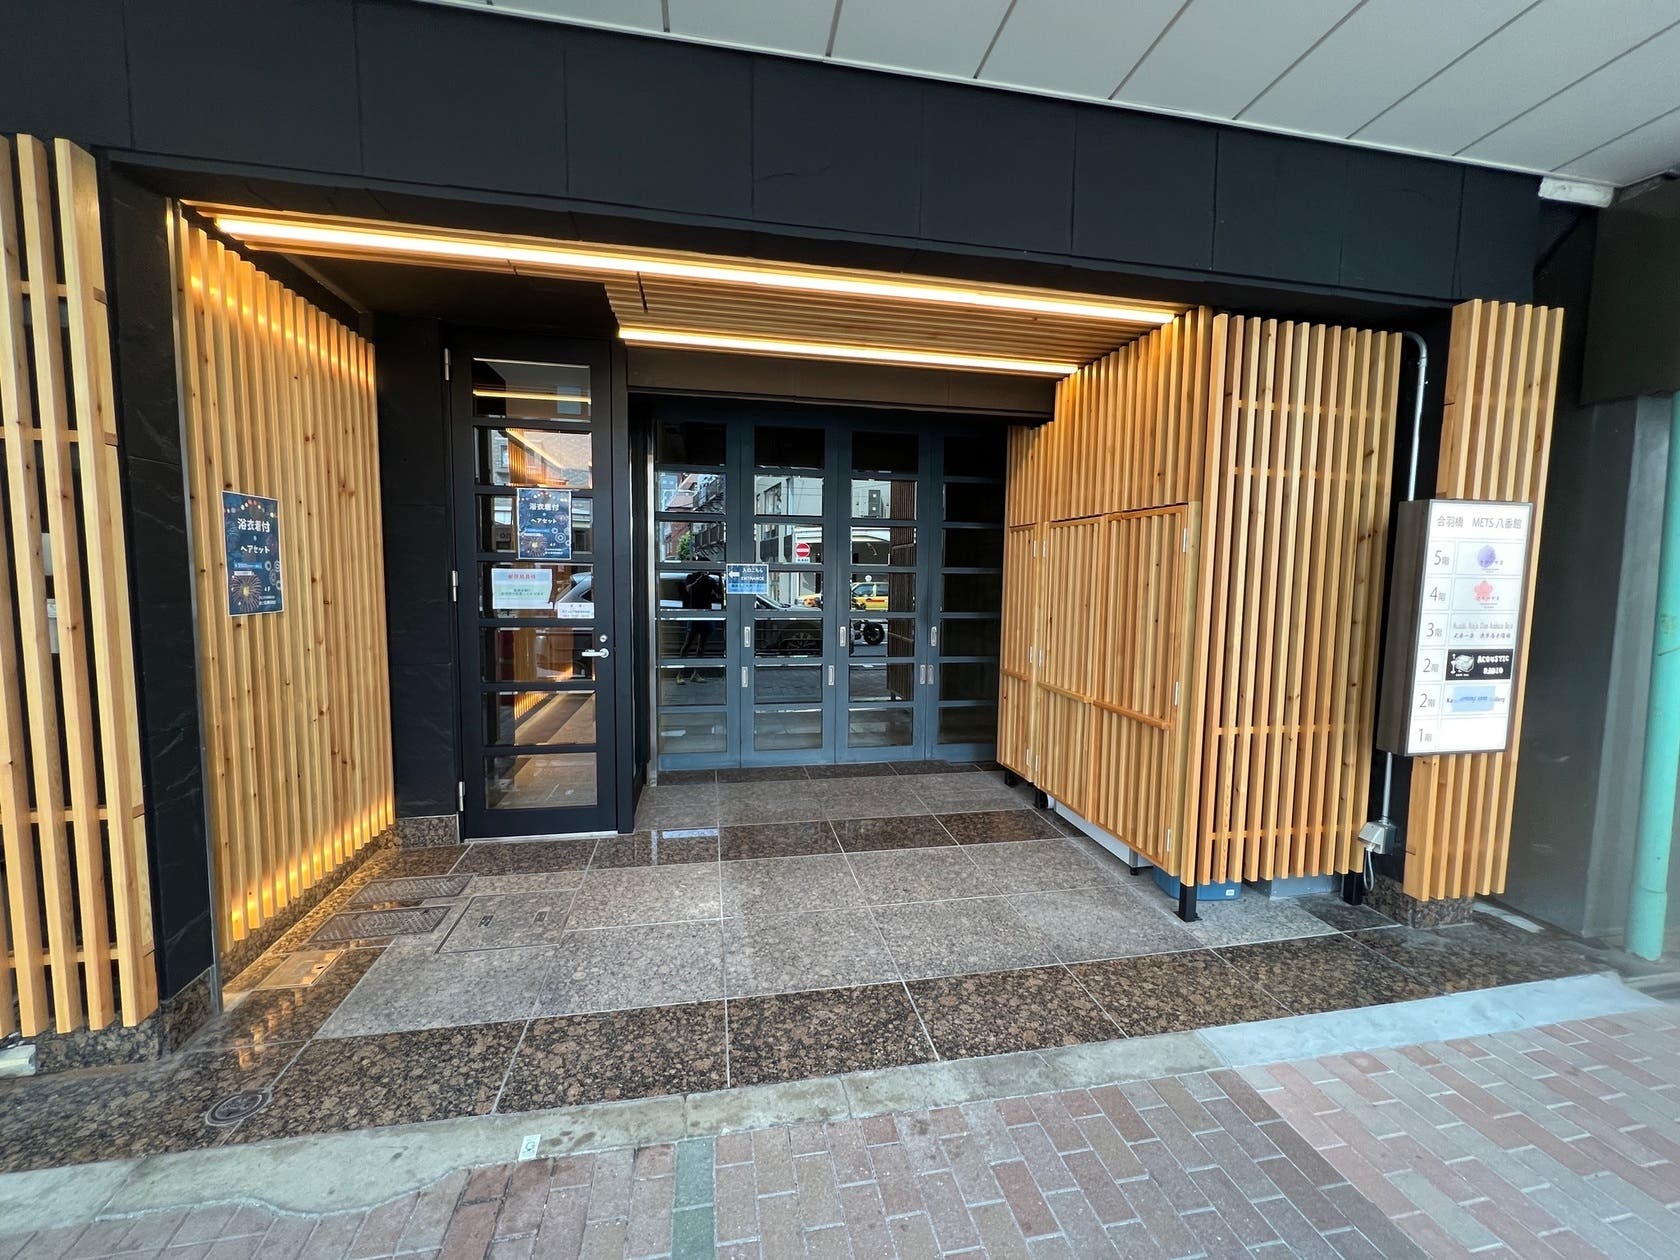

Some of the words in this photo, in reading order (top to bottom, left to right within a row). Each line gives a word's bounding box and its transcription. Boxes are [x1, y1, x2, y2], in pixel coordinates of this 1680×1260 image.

[529, 503, 560, 511] 浴衣着付
[237, 518, 270, 533] 浴衣着付
[1437, 516, 1464, 528] 合羽橋
[1472, 517, 1494, 528] METS
[1495, 518, 1522, 529] 八番館
[240, 545, 271, 554] ヘアセット
[1433, 549, 1450, 566] 5階
[1429, 586, 1446, 602] 4階
[1426, 622, 1442, 637] 3階
[1422, 658, 1439, 673] 2階
[1476, 655, 1510, 664] ACOUSTIC
[1482, 667, 1504, 675] RADIO
[1419, 693, 1436, 708] 2階
[1419, 728, 1433, 743] 1階
